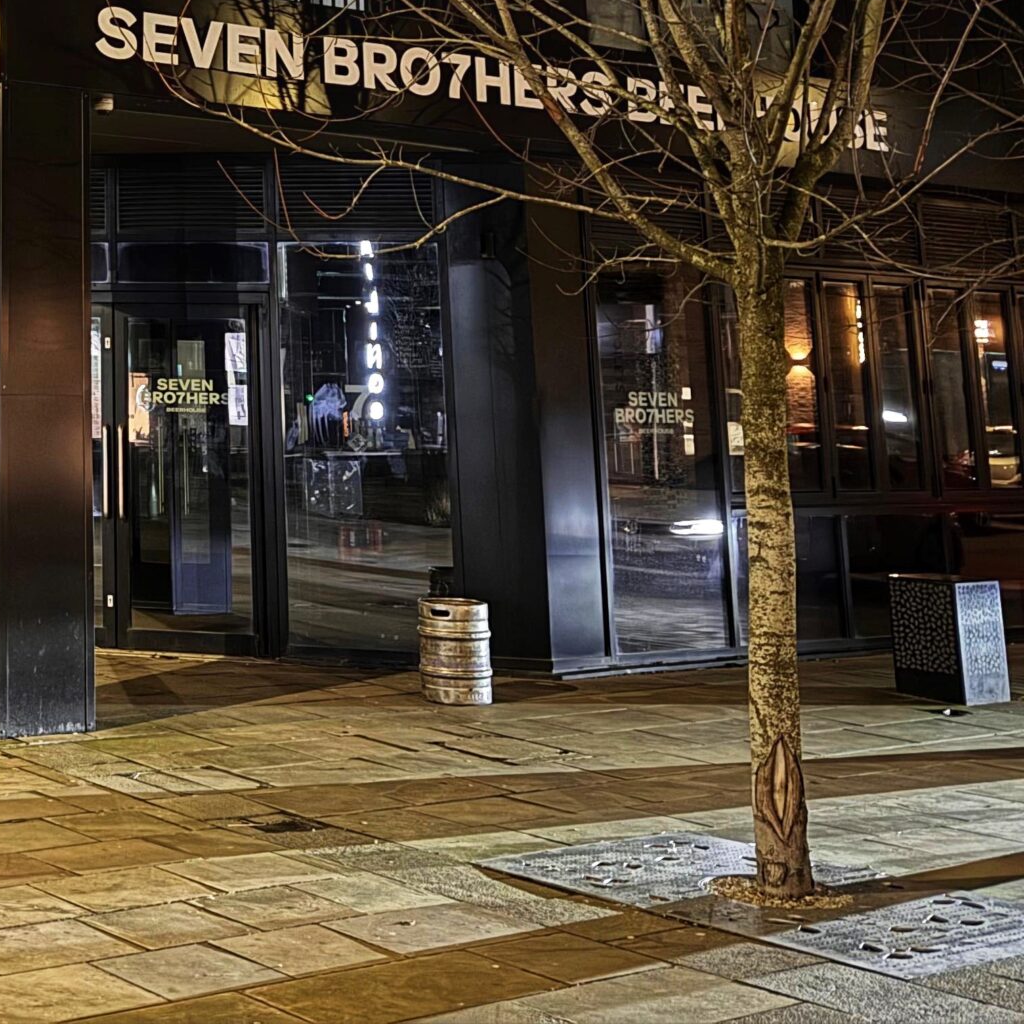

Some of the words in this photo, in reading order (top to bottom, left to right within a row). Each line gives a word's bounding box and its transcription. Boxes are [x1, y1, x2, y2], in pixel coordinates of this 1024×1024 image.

[95, 6, 305, 81] SEVEN
[157, 378, 214, 391] SEVEN
[628, 391, 678, 407] SEVEN
